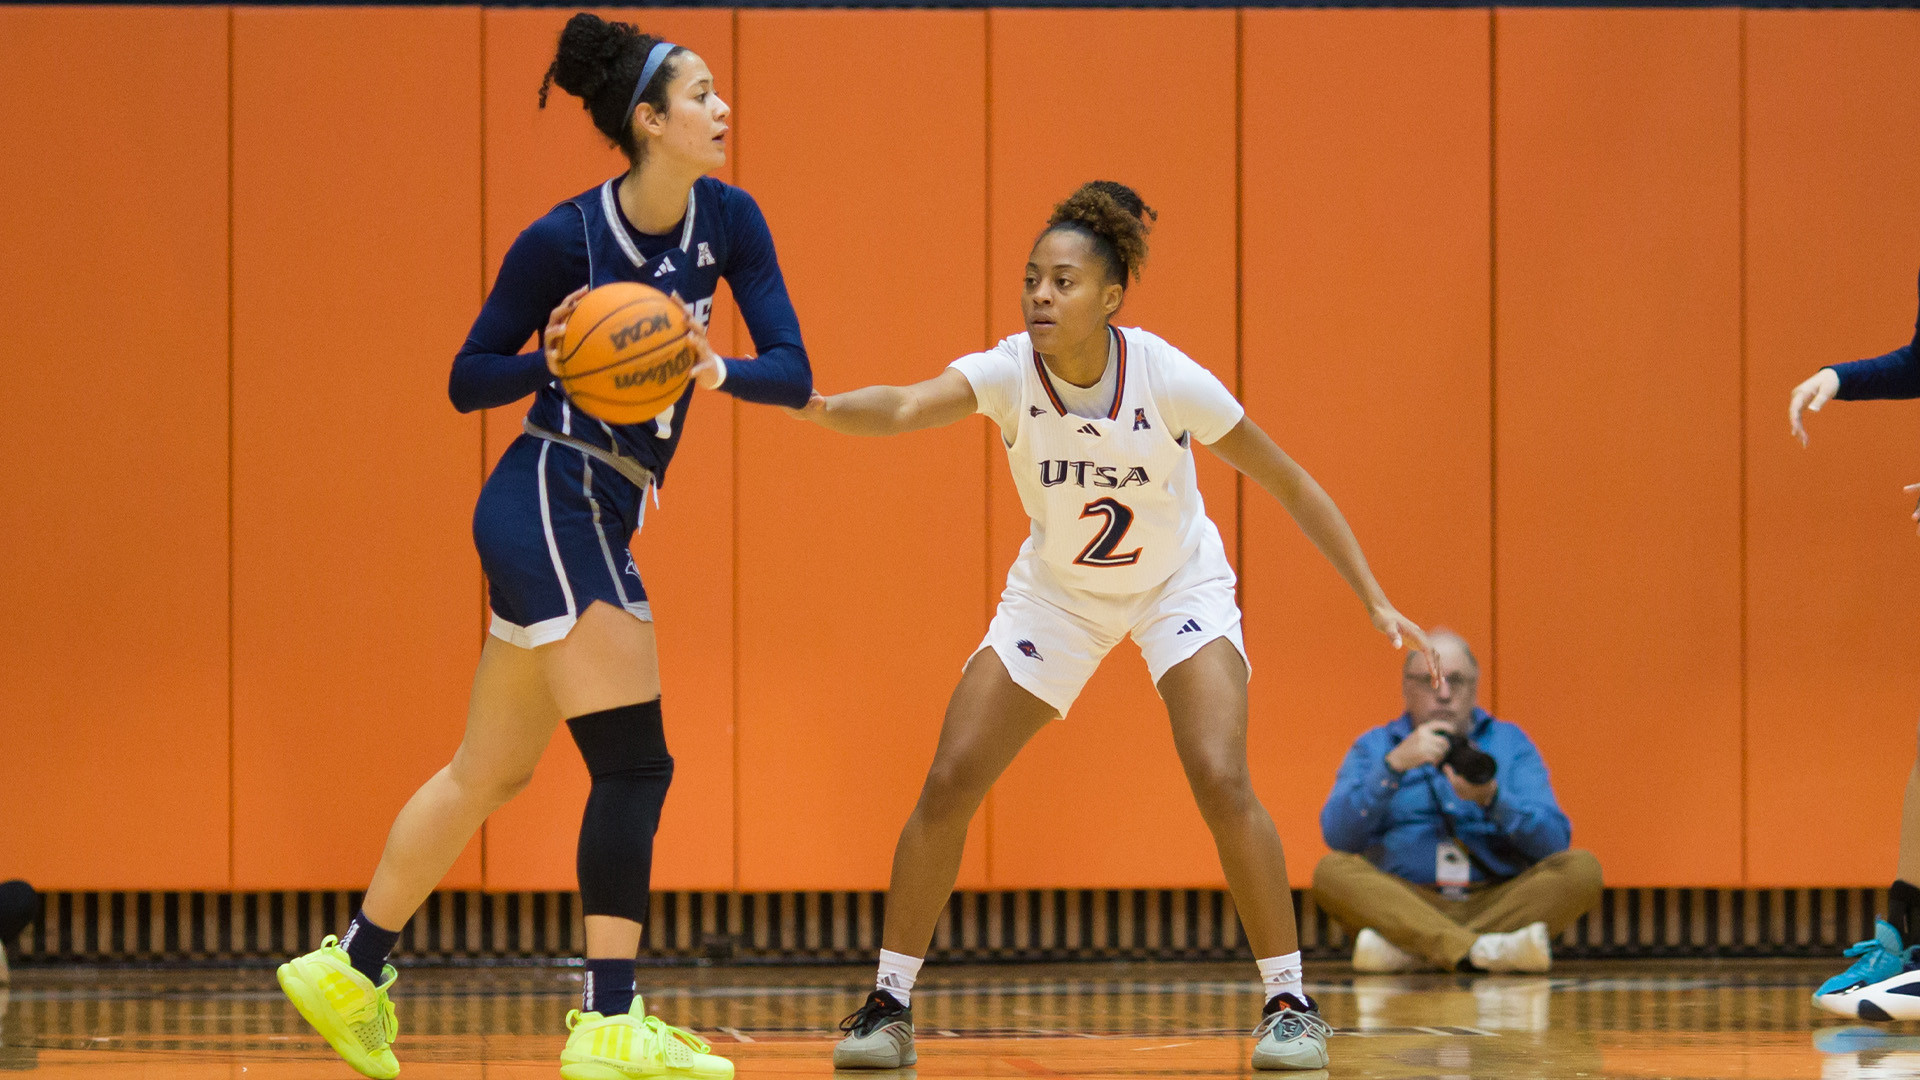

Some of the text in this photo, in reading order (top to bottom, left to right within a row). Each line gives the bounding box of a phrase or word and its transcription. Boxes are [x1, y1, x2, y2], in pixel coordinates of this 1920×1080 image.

[610, 314, 672, 351] NCAA
[615, 347, 691, 389] Wilson
[1038, 459, 1151, 489] UTSA
[1072, 496, 1143, 568] 2
